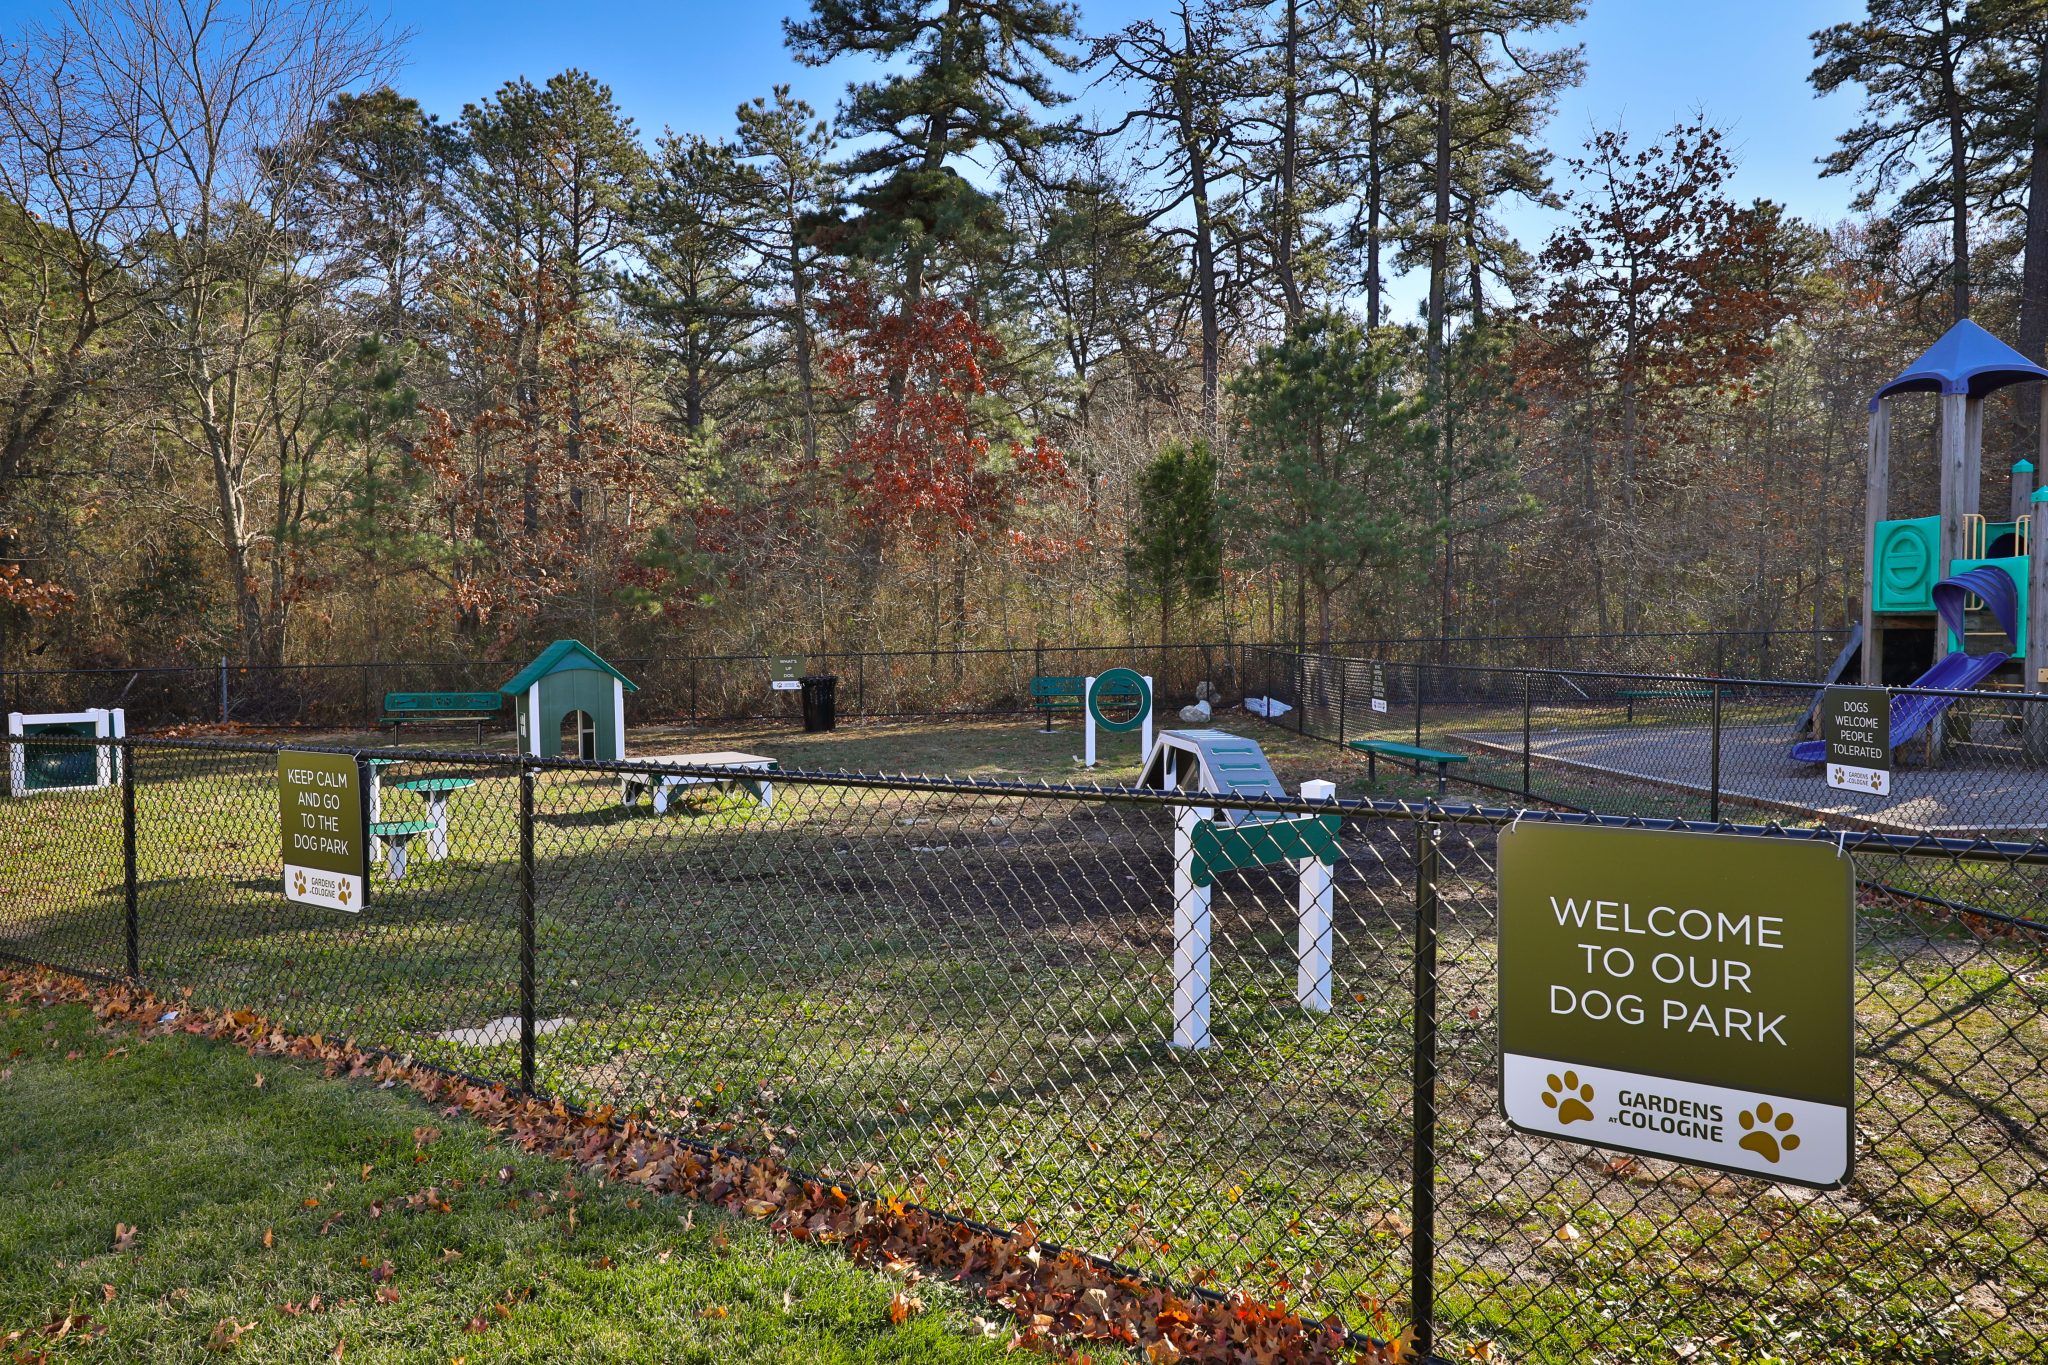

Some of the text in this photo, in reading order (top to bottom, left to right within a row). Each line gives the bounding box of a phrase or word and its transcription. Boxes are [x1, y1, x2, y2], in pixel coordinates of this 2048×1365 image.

[1843, 701, 1869, 713] DOGS
[1835, 715, 1879, 729] WELCOME
[1840, 730, 1873, 743] PEOPLE
[1833, 743, 1882, 759] TOLERATED
[287, 768, 348, 788] KEEP CALM
[298, 791, 340, 810] AND GO
[301, 812, 339, 832] TO THE
[294, 833, 349, 856] DOG PARK
[311, 877, 335, 889] GARDENS
[311, 886, 336, 899] COLOGNE
[1550, 896, 1784, 949] WELCOME
[1578, 943, 1752, 993] TO OUR
[1550, 984, 1788, 1046] DOG PARK
[1618, 1090, 1723, 1122] GARDENS
[1608, 1109, 1723, 1143] AT COLOGNE
